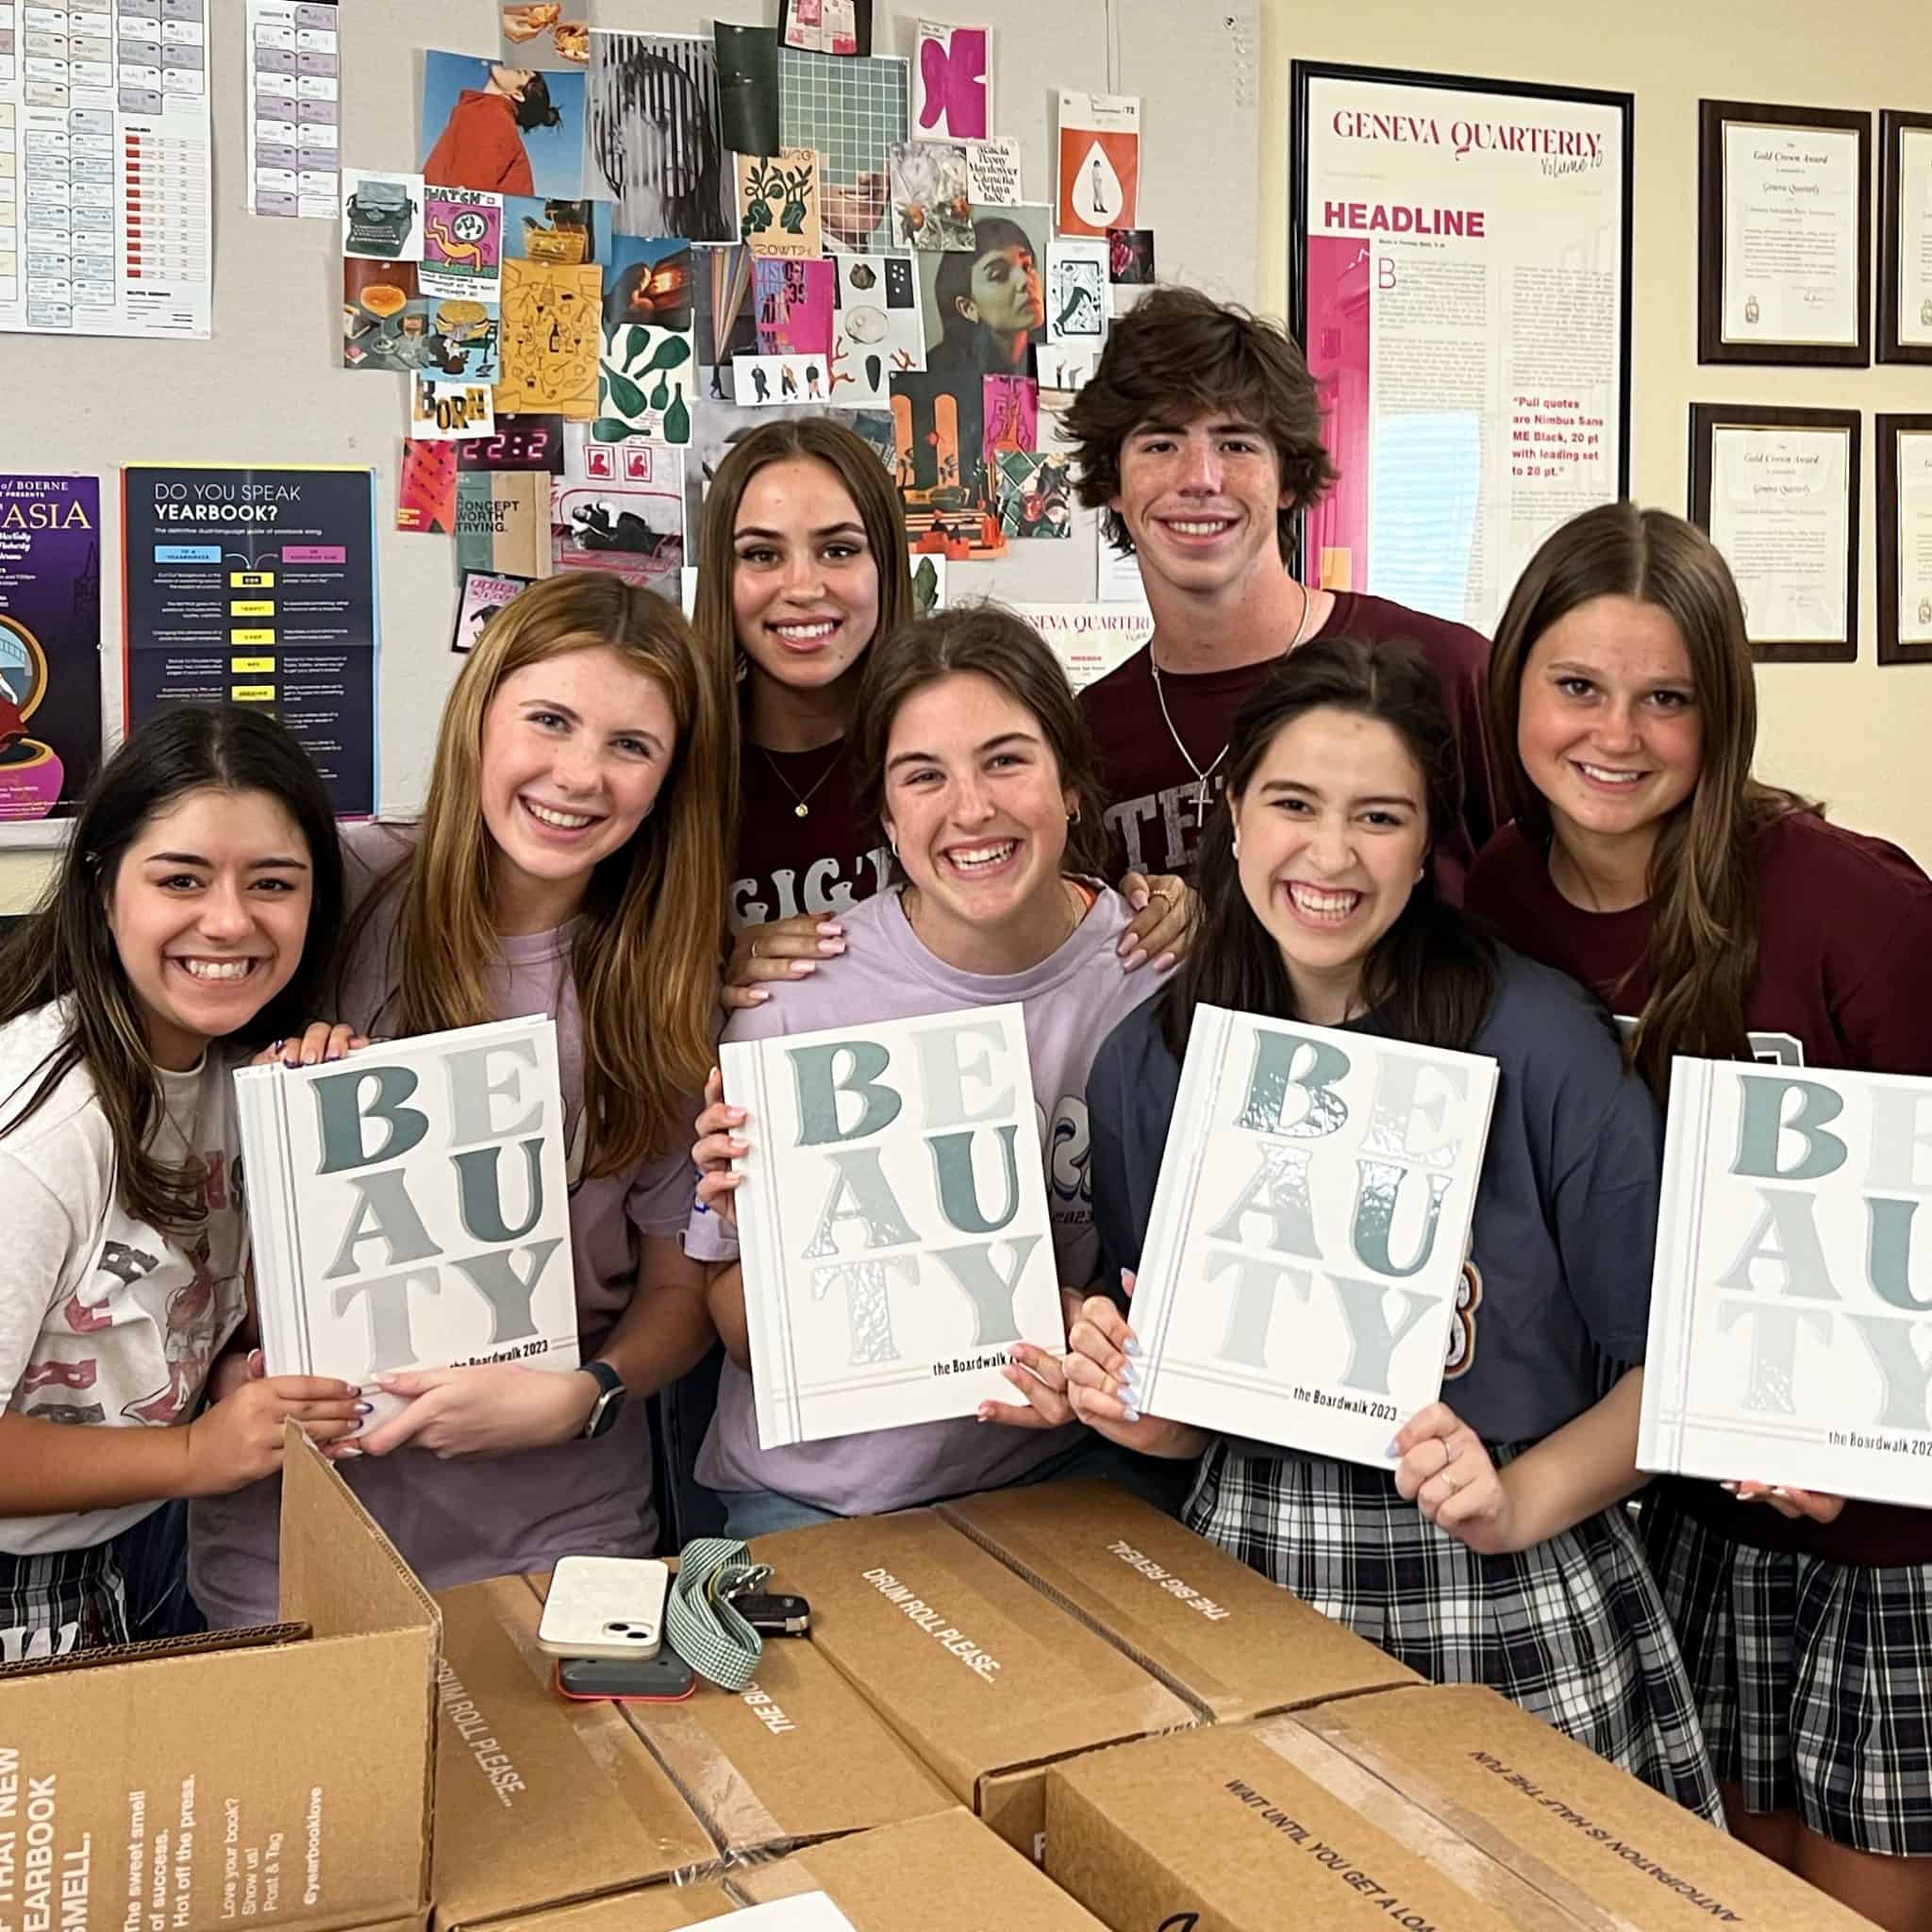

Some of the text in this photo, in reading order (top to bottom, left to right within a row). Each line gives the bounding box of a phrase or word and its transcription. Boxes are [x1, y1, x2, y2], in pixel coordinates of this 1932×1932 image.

[1333, 110, 1603, 161] GENEVA QUARTERLY
[1541, 157, 1588, 177] Volume
[1324, 201, 1485, 238] HEADLINE
[1378, 258, 1396, 289] B
[414, 374, 485, 431] BORN
[1543, 399, 1580, 408] quotes
[1535, 415, 1574, 425] Nimbus
[1579, 416, 1604, 425] Sans
[1513, 431, 1598, 445] ME Black, 20 pt
[1512, 448, 1599, 462] with leading set
[1512, 466, 1523, 475] to
[17, 482, 69, 491] BOERNE
[155, 483, 301, 501] DO YOU SPEAK
[0, 500, 92, 529] ASIA
[155, 504, 278, 521] YEARBOOK?
[457, 500, 520, 511] CONCEPT
[457, 511, 504, 521] WORTH
[457, 523, 508, 532] TRYING.
[469, 1340, 548, 1366] Boardwalk 2023
[933, 1361, 950, 1375] the
[953, 1352, 1006, 1373] Boardwalk
[1293, 1387, 1397, 1421] the Boardwalk 2023
[1829, 1431, 1847, 1446] the
[1850, 1431, 1908, 1454] Boardwalk
[862, 1568, 915, 1604] DRUM
[899, 1600, 946, 1633] ROLL
[1160, 1578, 1199, 1598] BIG
[1186, 1597, 1230, 1620] THE
[446, 1700, 490, 1740] ROLL
[753, 1705, 796, 1735] THE
[173, 1774, 196, 1927] Hot off the press.
[304, 1787, 323, 1905] @yearbooklove
[1224, 1779, 1271, 1808] WAIT
[1261, 1807, 1311, 1844] UNTIL
[1307, 1841, 1351, 1871] YOU
[1342, 1870, 1388, 1896] GET
[1374, 1898, 1398, 1910] A
[1468, 1751, 1743, 1922] ANTICIPATION IS HALF THE FUN
[124, 1790, 145, 1932] The sweet smell
[220, 1798, 240, 1919] Love your book?
[263, 1833, 284, 1911] Post & Tag
[148, 1828, 169, 1931] of success.
[242, 1847, 258, 1915] Show us!
